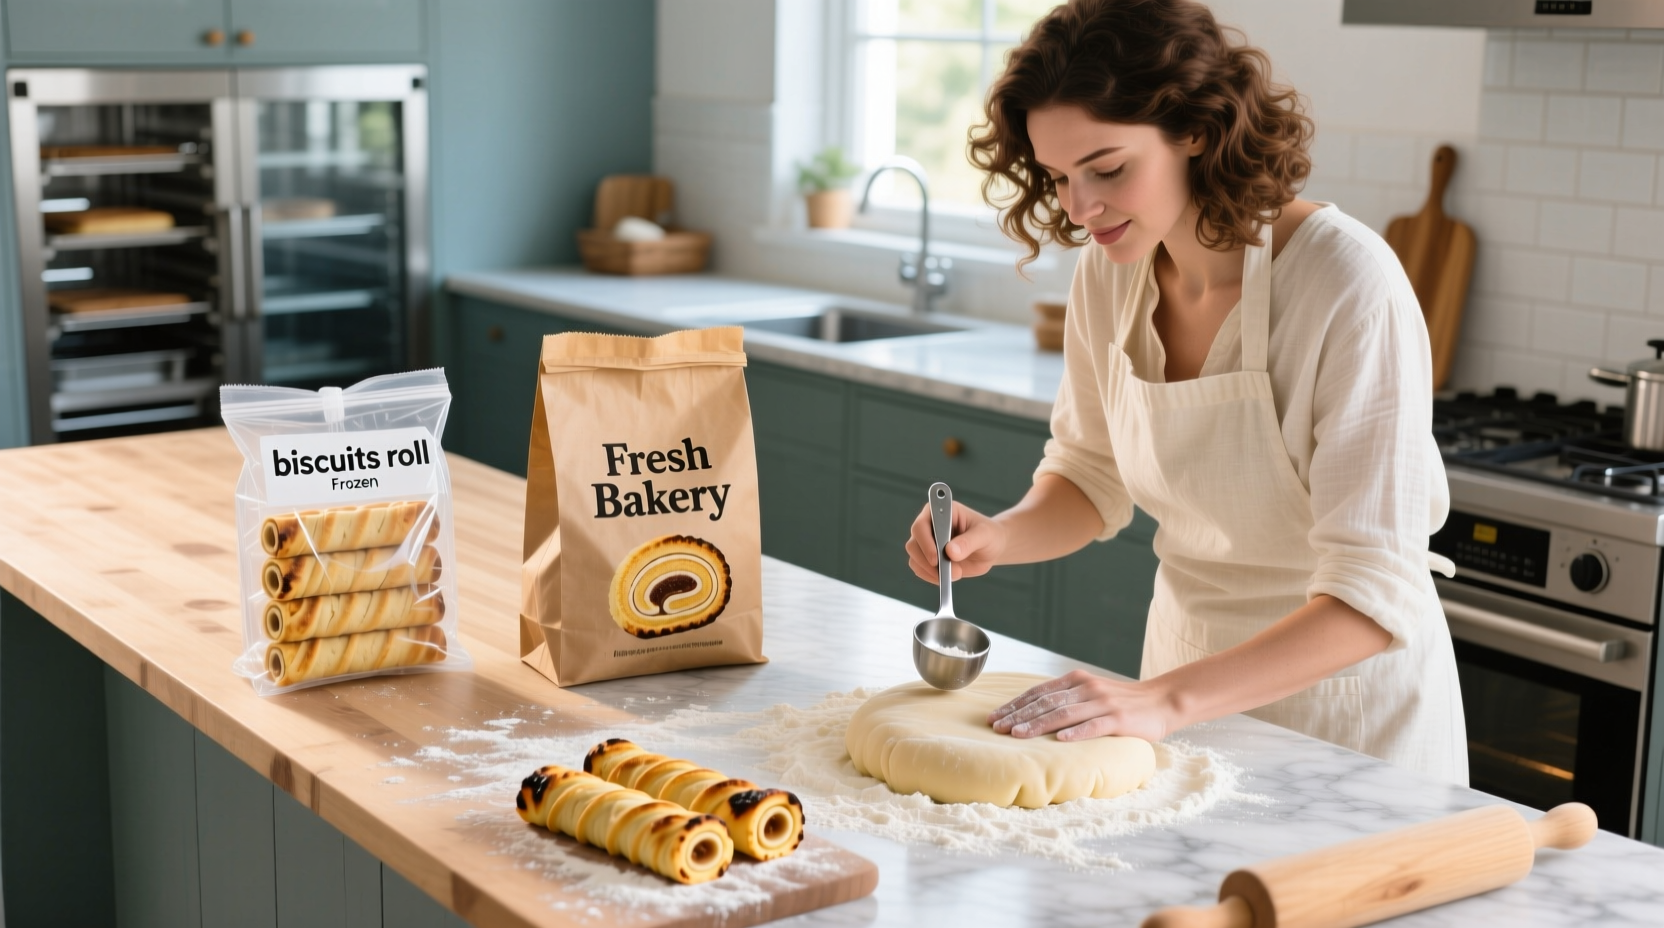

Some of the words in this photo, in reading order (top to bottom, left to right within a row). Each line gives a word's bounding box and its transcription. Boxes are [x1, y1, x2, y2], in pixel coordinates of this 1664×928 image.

[273, 446, 381, 476] biscuits
[387, 439, 430, 467] roll
[602, 437, 712, 476] Fresh
[331, 478, 379, 490] Frozen
[591, 480, 731, 521] Bakery
